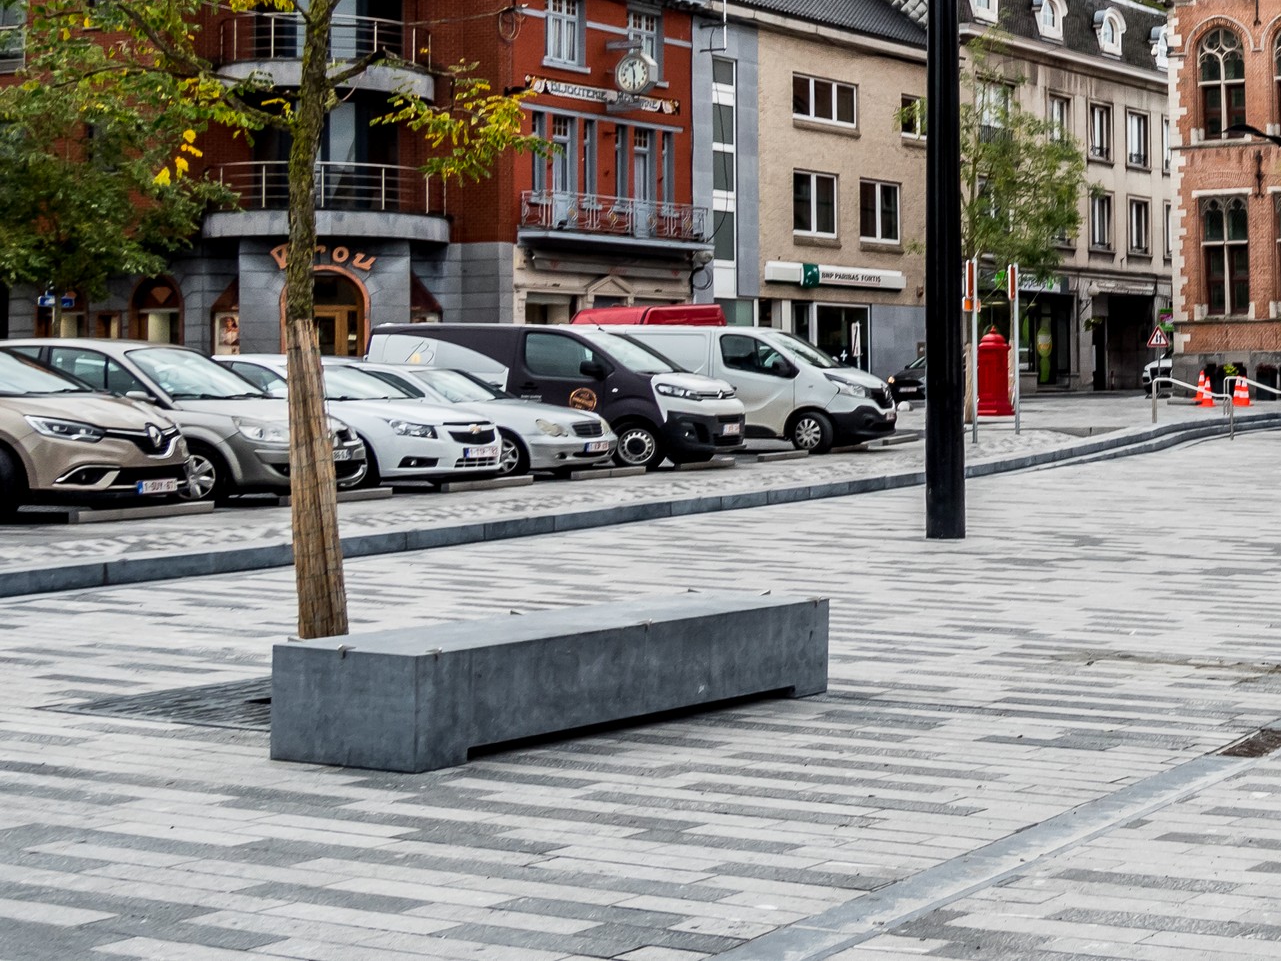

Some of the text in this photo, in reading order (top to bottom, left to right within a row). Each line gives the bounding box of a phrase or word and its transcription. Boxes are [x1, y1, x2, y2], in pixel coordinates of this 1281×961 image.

[550, 79, 607, 102] BIJOUTERIE
[834, 273, 859, 281] PARIBAS
[861, 274, 881, 283] FORTIS
